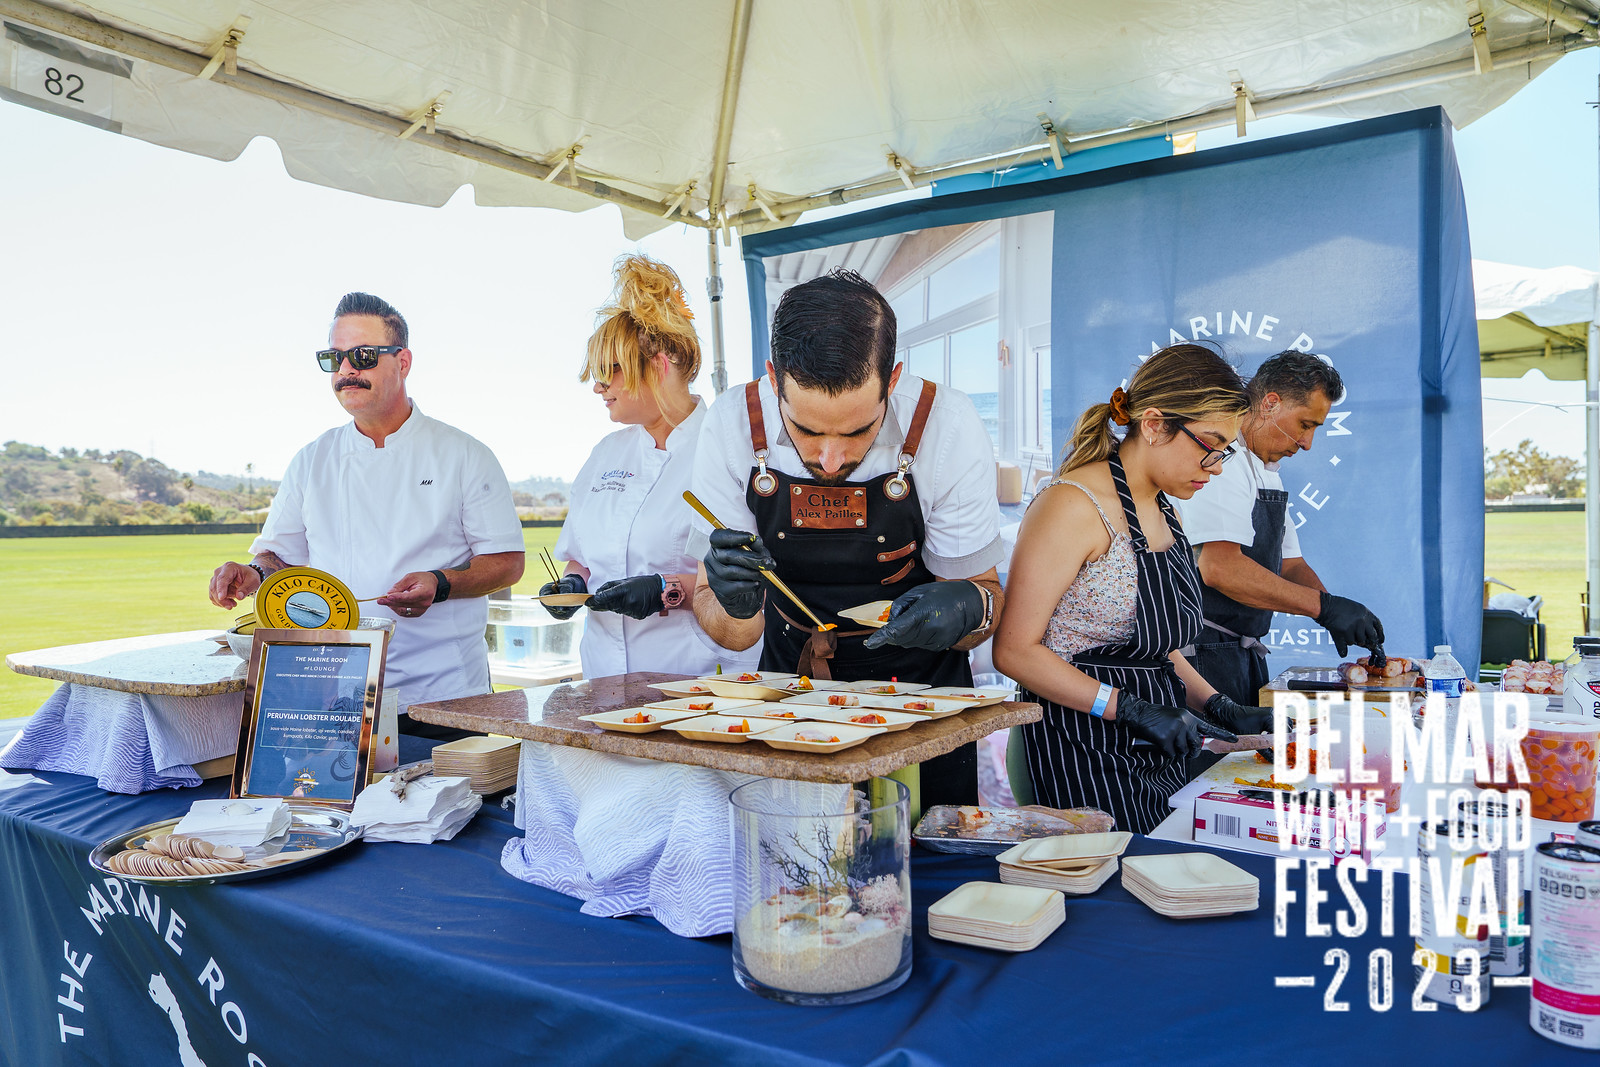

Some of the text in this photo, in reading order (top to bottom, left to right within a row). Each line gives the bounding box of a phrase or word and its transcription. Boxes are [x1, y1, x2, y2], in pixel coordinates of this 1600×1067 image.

[44, 67, 84, 103] 82
[808, 494, 850, 507] Chef
[796, 508, 863, 518] Alex Pailles
[272, 578, 302, 598] KILO
[308, 579, 346, 614] CAVIAR
[266, 712, 361, 723] PERUVIAN LOBSTER ROULADE
[297, 767, 316, 777] KILO
[57, 939, 93, 1043] THE
[80, 877, 187, 956] MARINE
